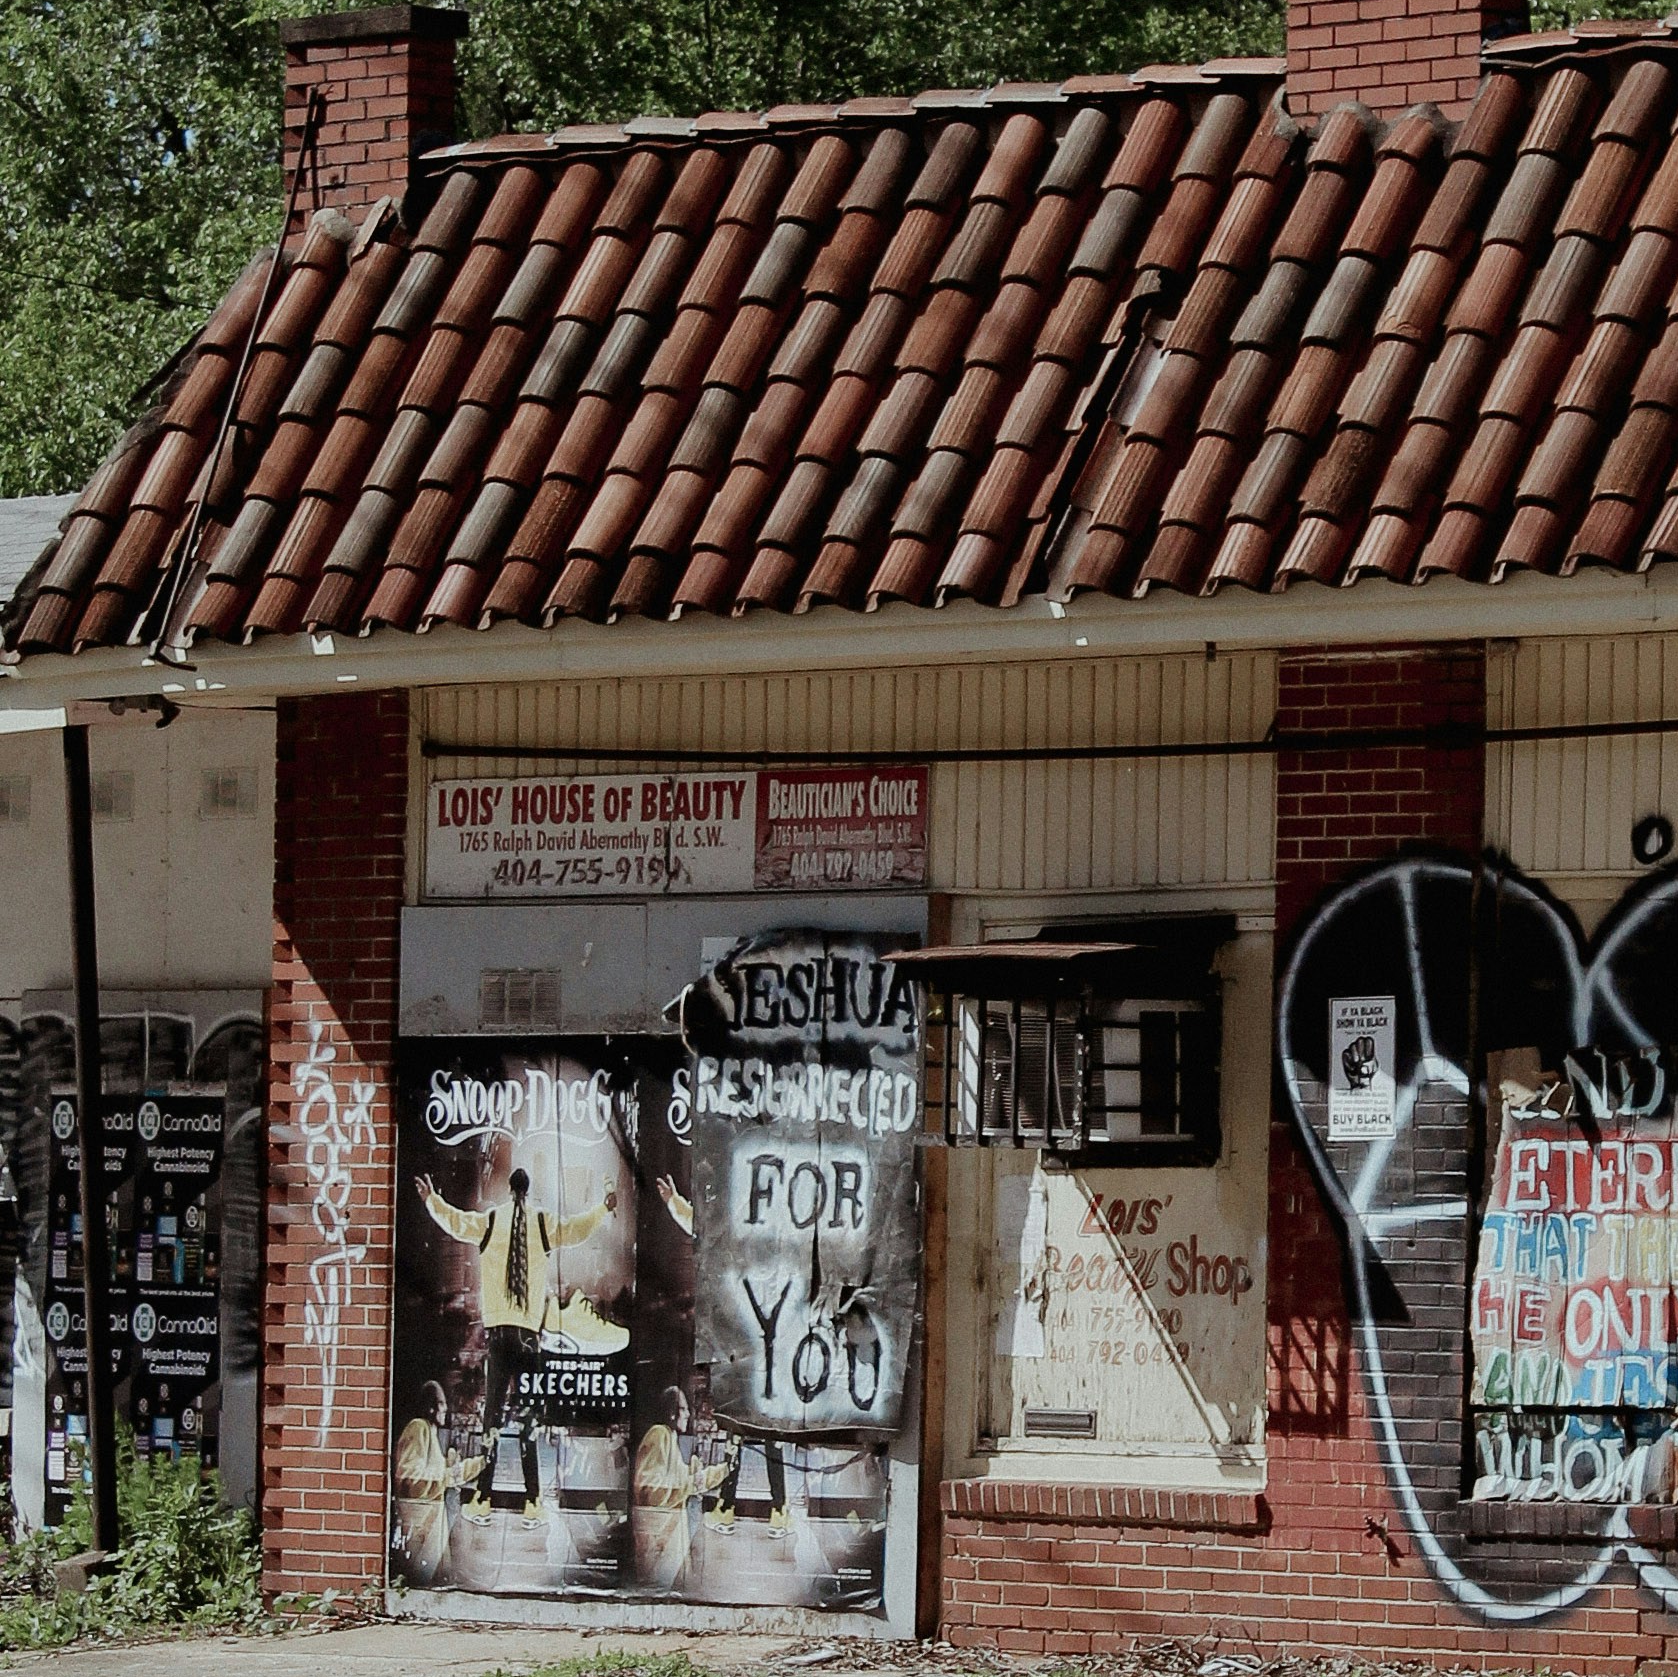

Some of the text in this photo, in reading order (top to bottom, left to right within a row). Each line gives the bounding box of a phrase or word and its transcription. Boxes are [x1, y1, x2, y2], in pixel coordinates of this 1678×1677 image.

[438, 779, 747, 828] LOIS' HOUSE OF BEAUTY
[459, 830, 489, 853] 1765
[493, 829, 532, 856] Ralph
[536, 828, 576, 850] David
[579, 827, 650, 854] Abernathy
[693, 825, 724, 848] S.W.
[425, 1069, 524, 1134] SNOOP
[525, 1068, 614, 1133] DOGG
[1333, 1113, 1392, 1125] BUY BLACK
[147, 1146, 215, 1161] Highest Potency
[748, 1153, 865, 1230] FOR
[1166, 1233, 1253, 1306] Shop
[1482, 1211, 1597, 1284] THAT
[142, 1348, 211, 1364] Highest Potency
[519, 1372, 630, 1396] SKECHERS
[1476, 1427, 1651, 1503] WHOM
